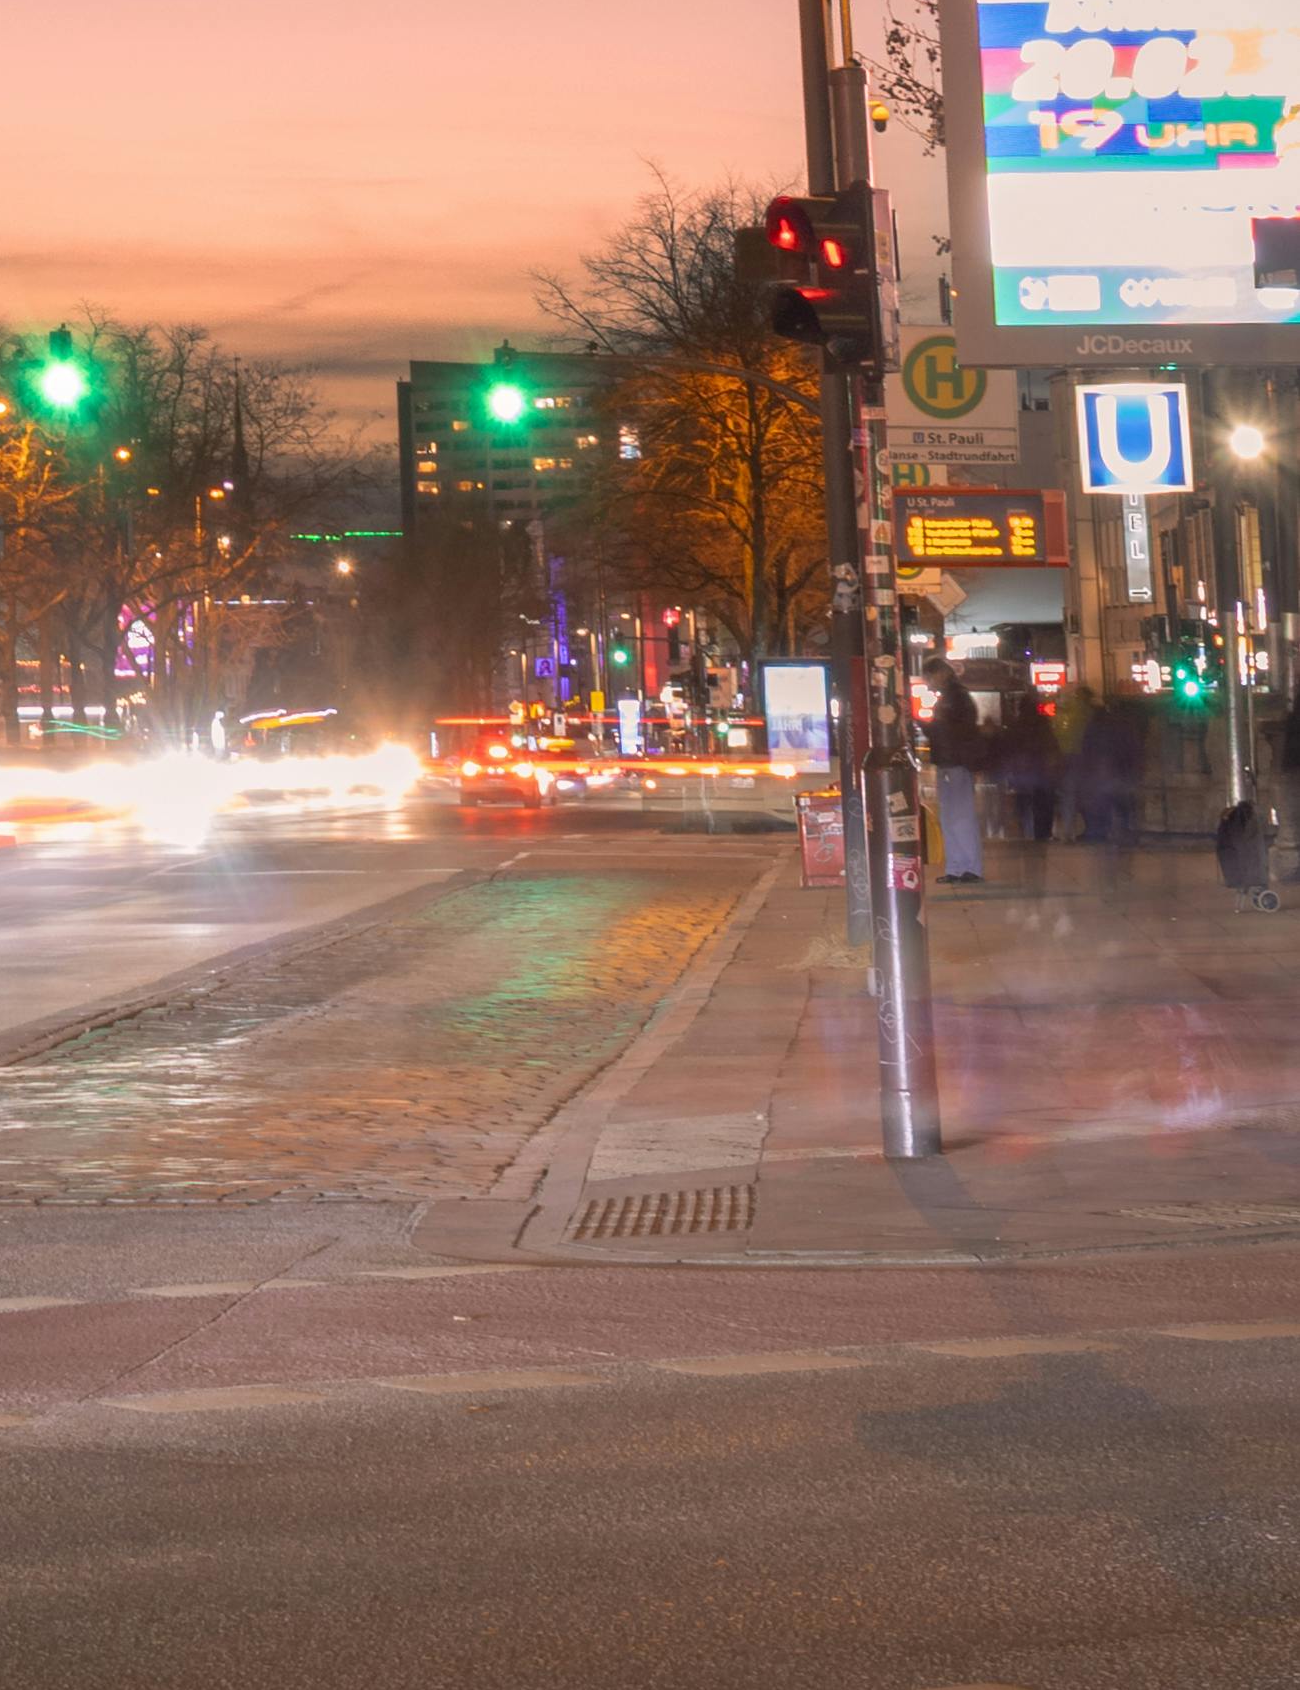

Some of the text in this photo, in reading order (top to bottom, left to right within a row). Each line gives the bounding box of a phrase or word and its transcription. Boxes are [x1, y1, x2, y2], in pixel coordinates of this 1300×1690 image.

[1028, 108, 1258, 150] 19 UHR
[1076, 334, 1193, 355] JCDecaux
[925, 355, 965, 399] H
[927, 432, 946, 444] St.
[948, 432, 984, 445] Pauli
[1095, 393, 1171, 486] U
[928, 450, 1015, 462] Stadtrundfahrt
[906, 498, 915, 507] U
[931, 497, 955, 507] Pauli
